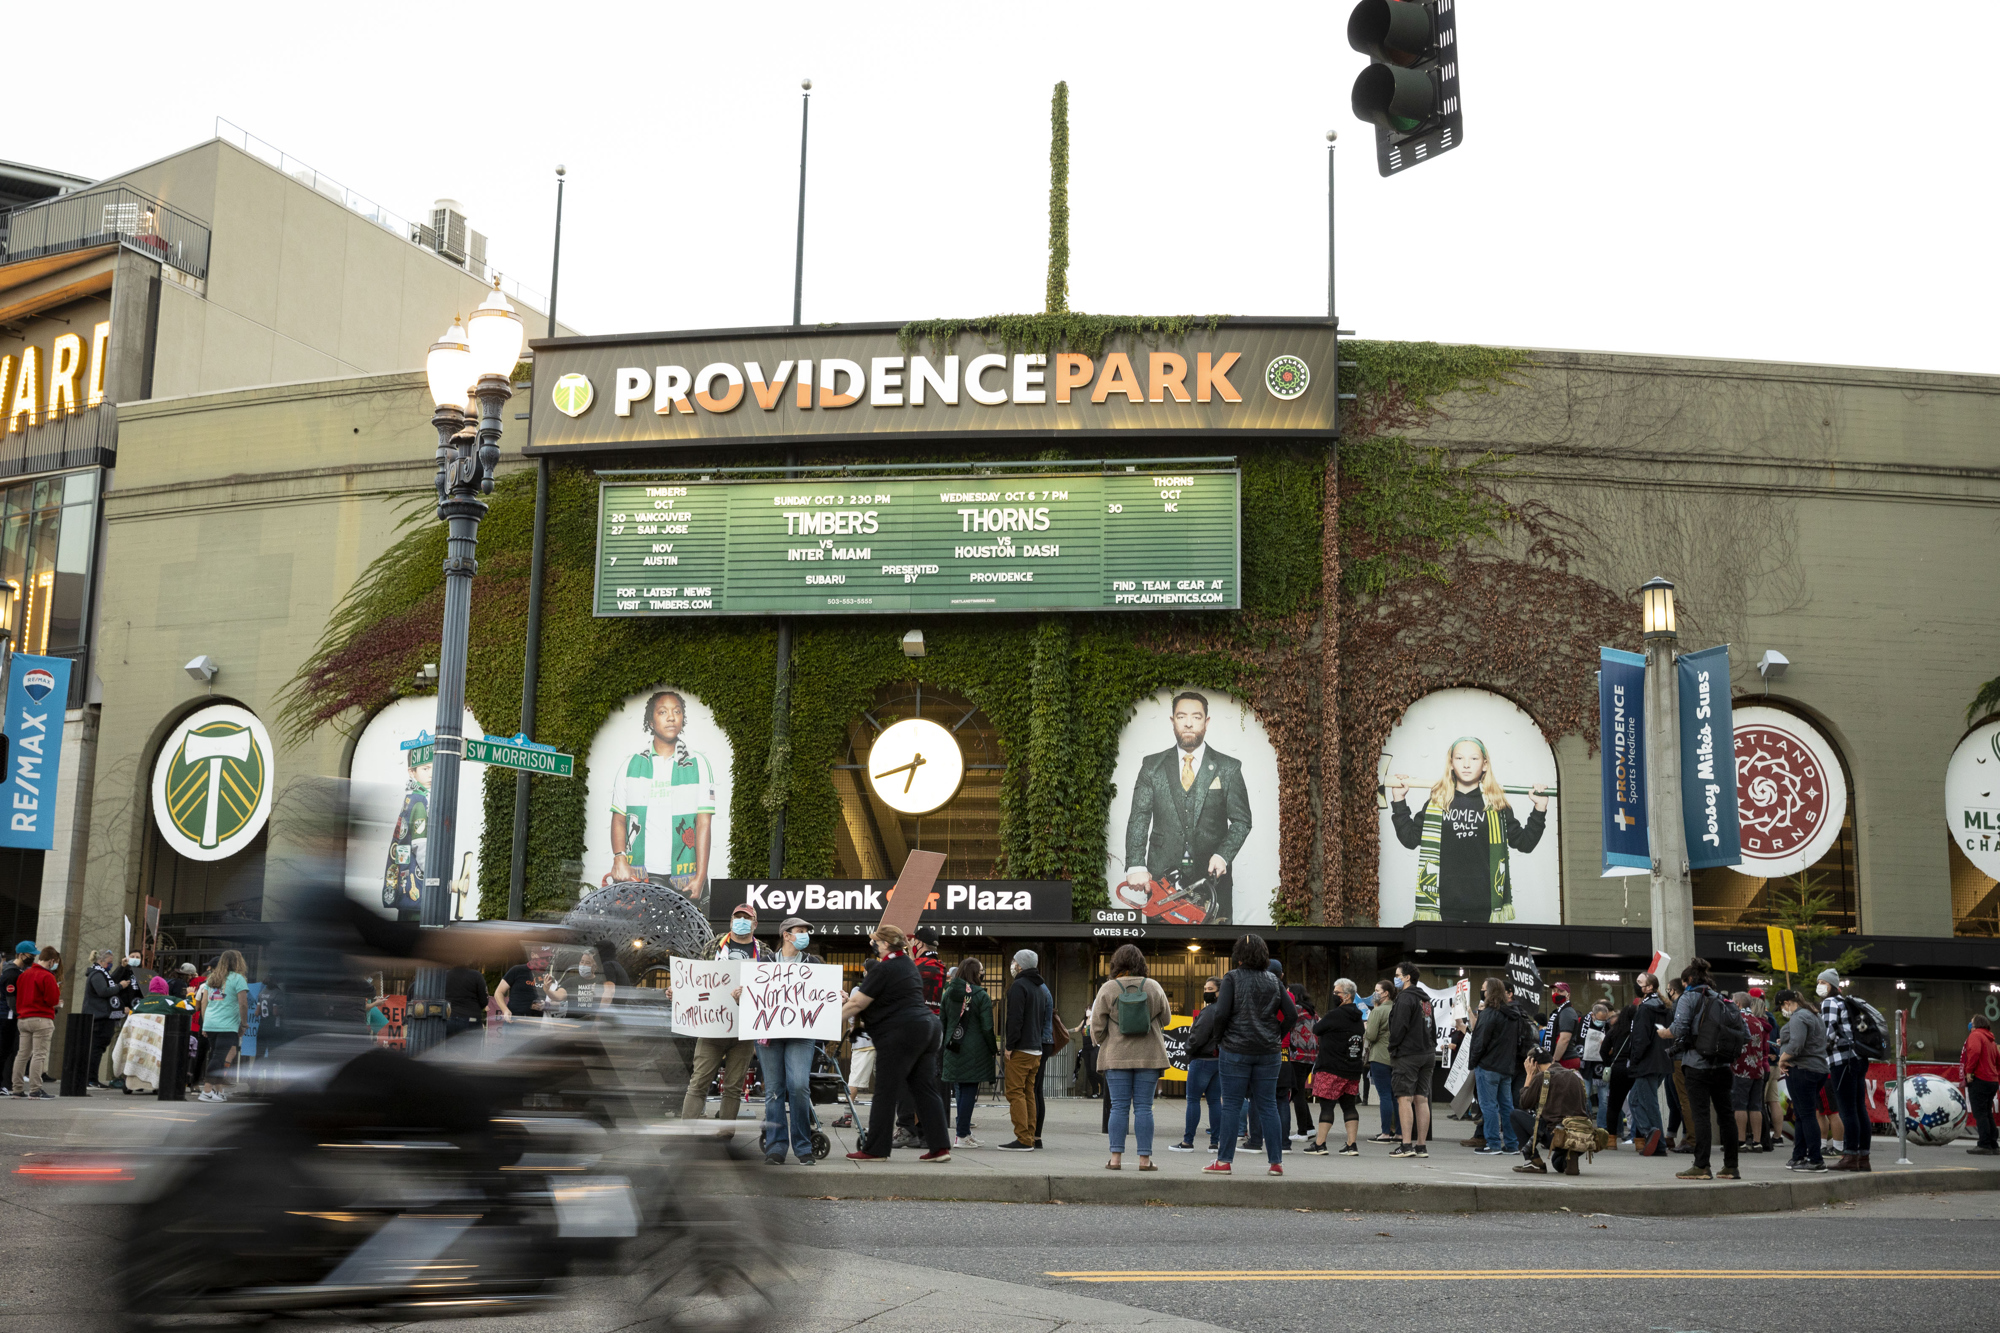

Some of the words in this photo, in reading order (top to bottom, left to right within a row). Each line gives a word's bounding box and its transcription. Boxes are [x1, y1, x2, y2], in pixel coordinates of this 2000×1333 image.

[1152, 476, 1194, 487] THORNS
[645, 487, 687, 497] TIMBERS
[940, 492, 1001, 503] WEDNESDAY
[1005, 491, 1026, 502] OCT
[1028, 491, 1035, 501] 6
[1042, 491, 1049, 501] 7
[1051, 490, 1068, 501] PM
[1160, 489, 1181, 500] OCT
[654, 499, 675, 510] OCT
[773, 496, 812, 506] SUNDAY
[814, 495, 835, 505] OCT
[837, 495, 844, 505] 3
[874, 494, 891, 504] PM
[1108, 503, 1123, 514] 30
[1164, 502, 1178, 513] NC
[611, 513, 626, 523] 20
[634, 512, 692, 522] VANCOUVER
[782, 510, 879, 536] TIMBERS
[957, 507, 1051, 533] THORNS
[611, 525, 625, 535] 27
[637, 525, 658, 535] SAN
[661, 524, 688, 535] JOSE
[818, 539, 833, 549] VS
[997, 536, 1012, 546] VS
[652, 543, 674, 553] NOV
[954, 545, 1016, 558] HOUSTON
[1023, 545, 1060, 557] DASH
[787, 548, 824, 561] INTER
[831, 548, 871, 561] MIAMI
[610, 556, 617, 566] 7
[643, 556, 678, 566] AUSTIN
[882, 565, 939, 575] PRESENTED
[805, 575, 846, 585] SUBARU
[904, 574, 918, 584] BY
[969, 572, 1033, 583] PROVIDENCE
[1113, 581, 1136, 591] FIND
[1141, 580, 1171, 591] TEAM
[1176, 580, 1205, 590] GEAR
[1210, 579, 1224, 590] AT
[616, 588, 637, 598] FOR
[643, 587, 678, 597] LATEST
[683, 587, 712, 597] NEWS
[1115, 592, 1223, 604] PTFCAUTHENTICS.COM
[617, 600, 640, 611] VISIT
[649, 599, 712, 610] TIMBERS.COM
[489, 736, 508, 744] GOOSE
[1614, 684, 1626, 803] PROVIDENCE
[1627, 717, 1636, 766] Medicine
[412, 749, 422, 764] SW
[1697, 722, 1715, 780] Mike's
[468, 742, 487, 760] SW
[491, 746, 556, 771] MORRISON
[560, 764, 569, 773] ST
[1628, 777, 1638, 804] Sports
[1443, 808, 1485, 824] WOMEN
[1702, 784, 1720, 847] Jersey
[1452, 822, 1478, 831] BALL
[1456, 831, 1478, 840] TOO.
[746, 884, 883, 915] KeyBank
[946, 885, 1032, 911] Plaza
[1097, 910, 1123, 922] Gate
[1126, 911, 1137, 922] D
[854, 925, 876, 935] SW
[1093, 927, 1121, 937] GATES
[1123, 927, 1139, 937] E-G
[1726, 941, 1763, 953] Tickets
[675, 960, 731, 989] Silence
[1511, 969, 1534, 987] LIVES
[1909, 991, 1922, 1019] 7
[1985, 994, 2000, 1022] 8
[752, 1002, 825, 1031] NOW
